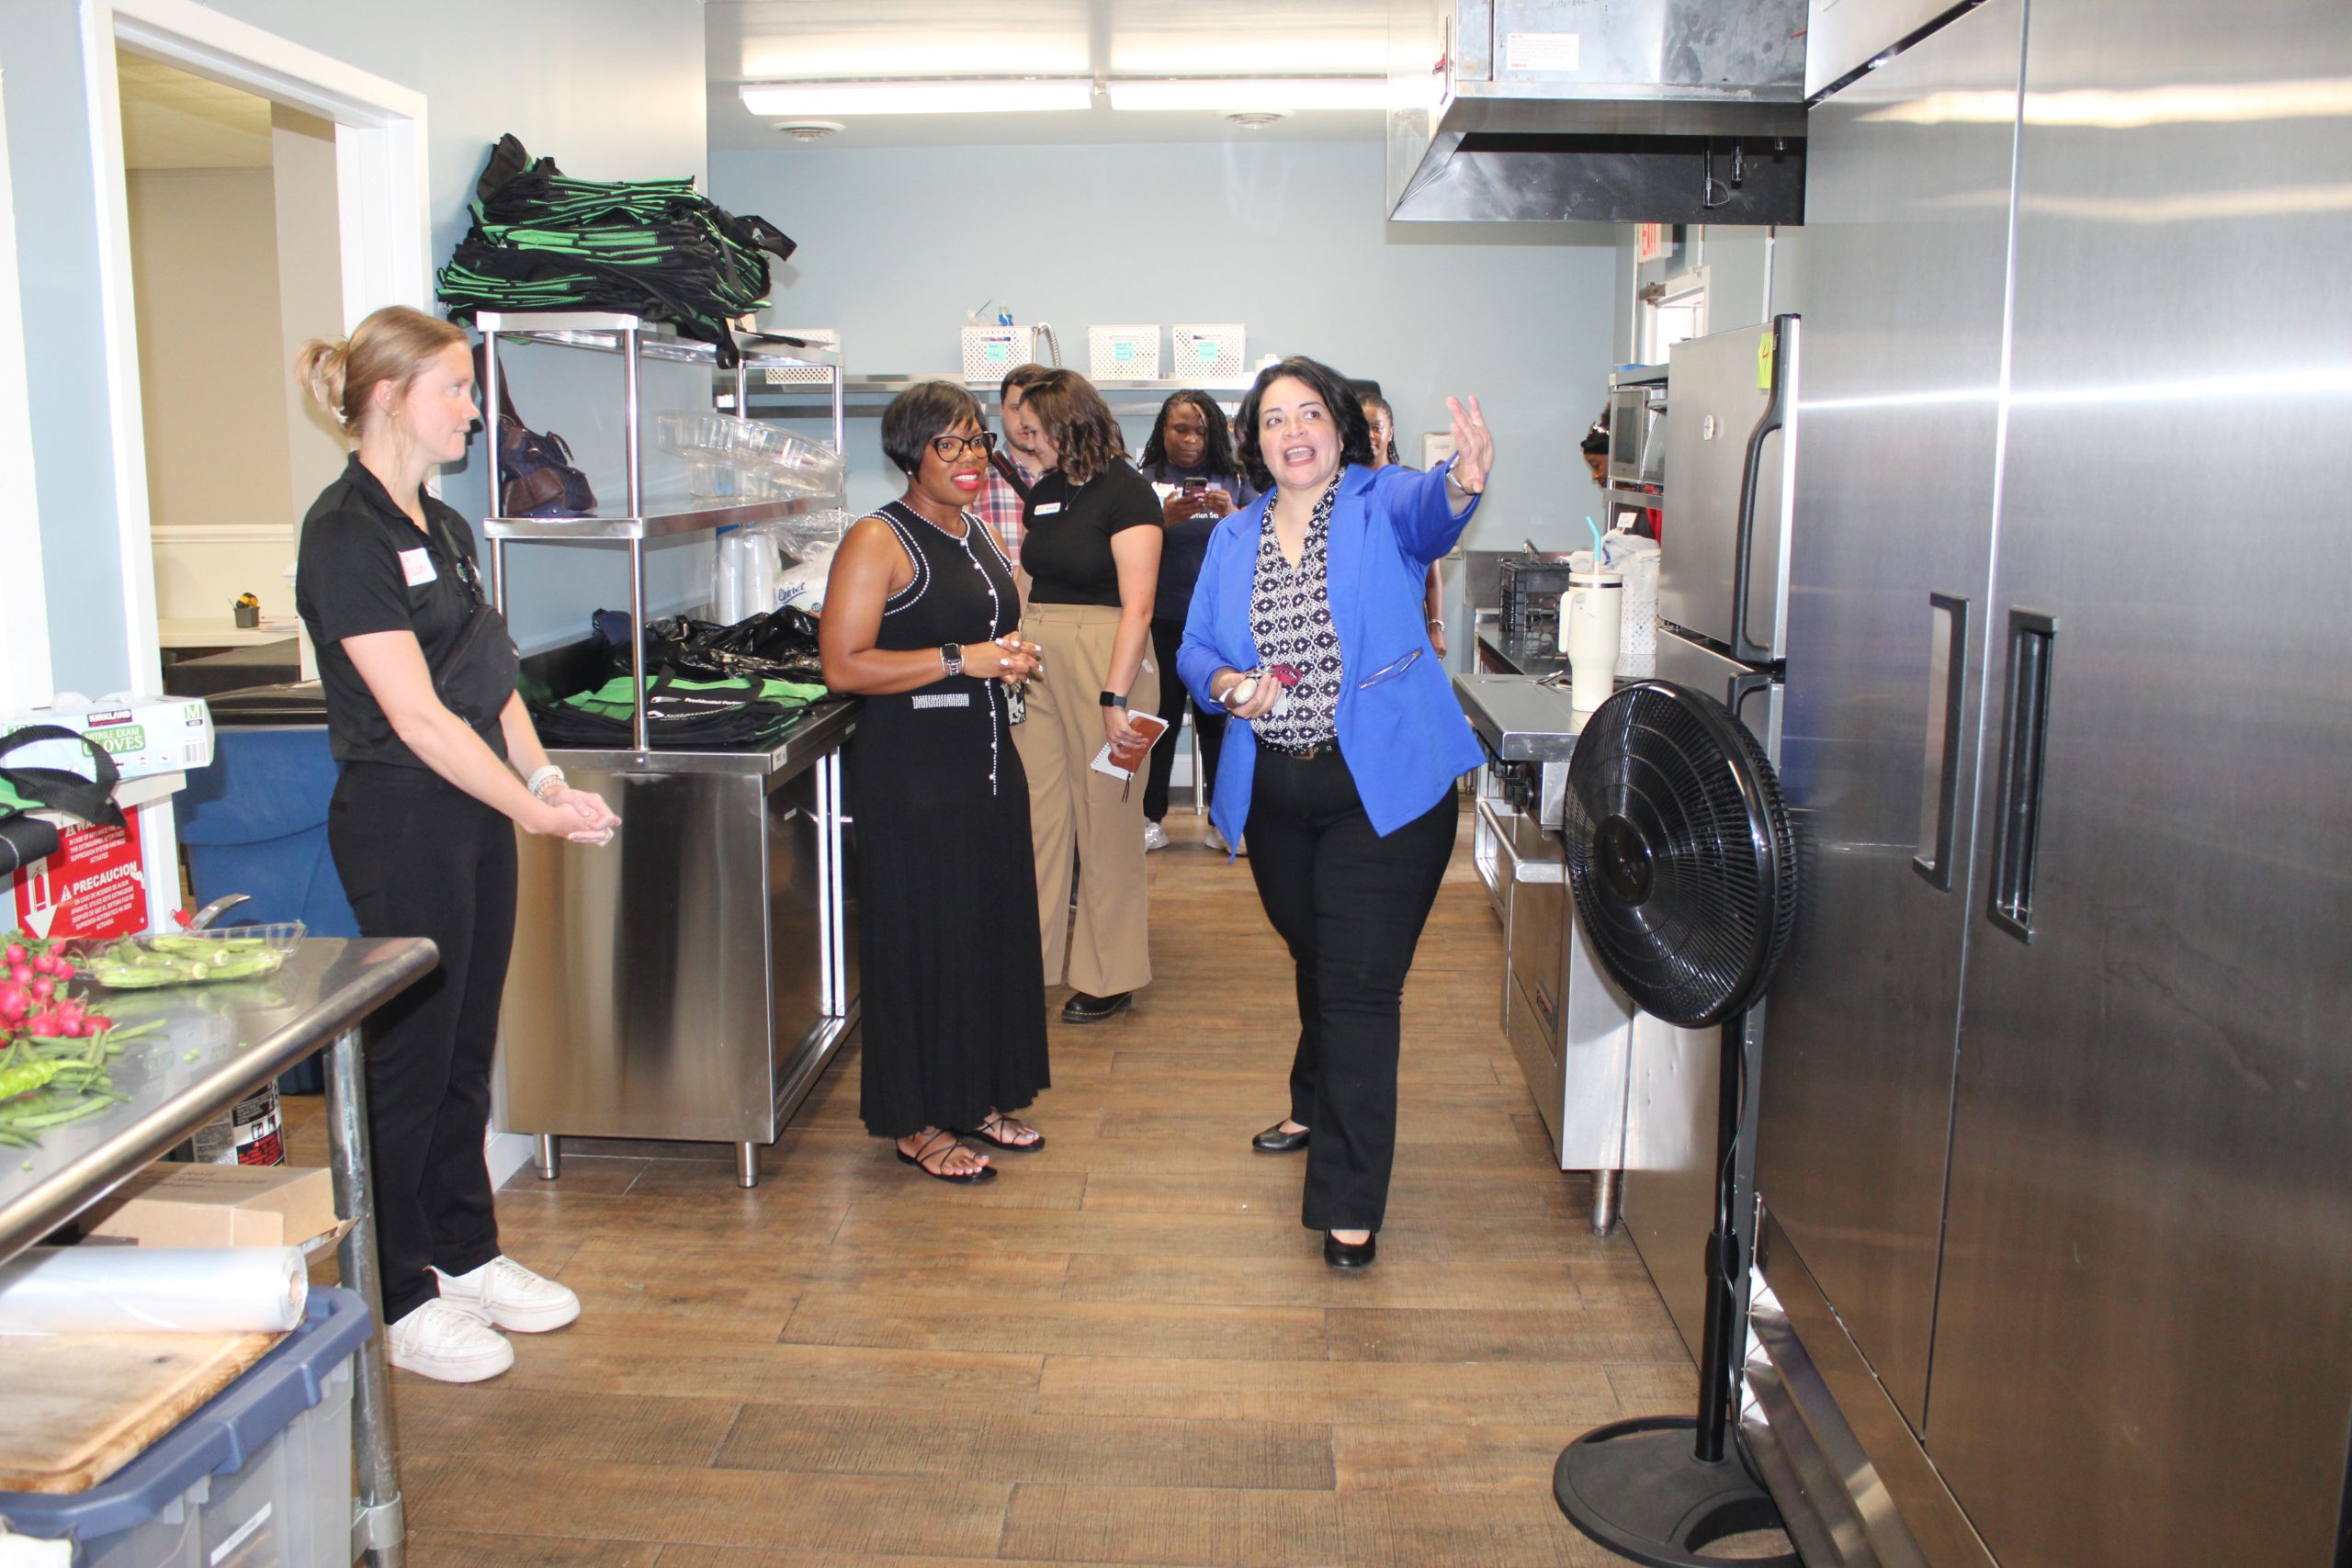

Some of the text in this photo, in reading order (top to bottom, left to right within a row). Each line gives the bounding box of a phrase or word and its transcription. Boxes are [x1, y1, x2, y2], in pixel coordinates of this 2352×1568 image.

[88, 710, 130, 723] KIRKLAND
[116, 726, 140, 739] EXAM
[73, 861, 137, 896] PRECAUCION
